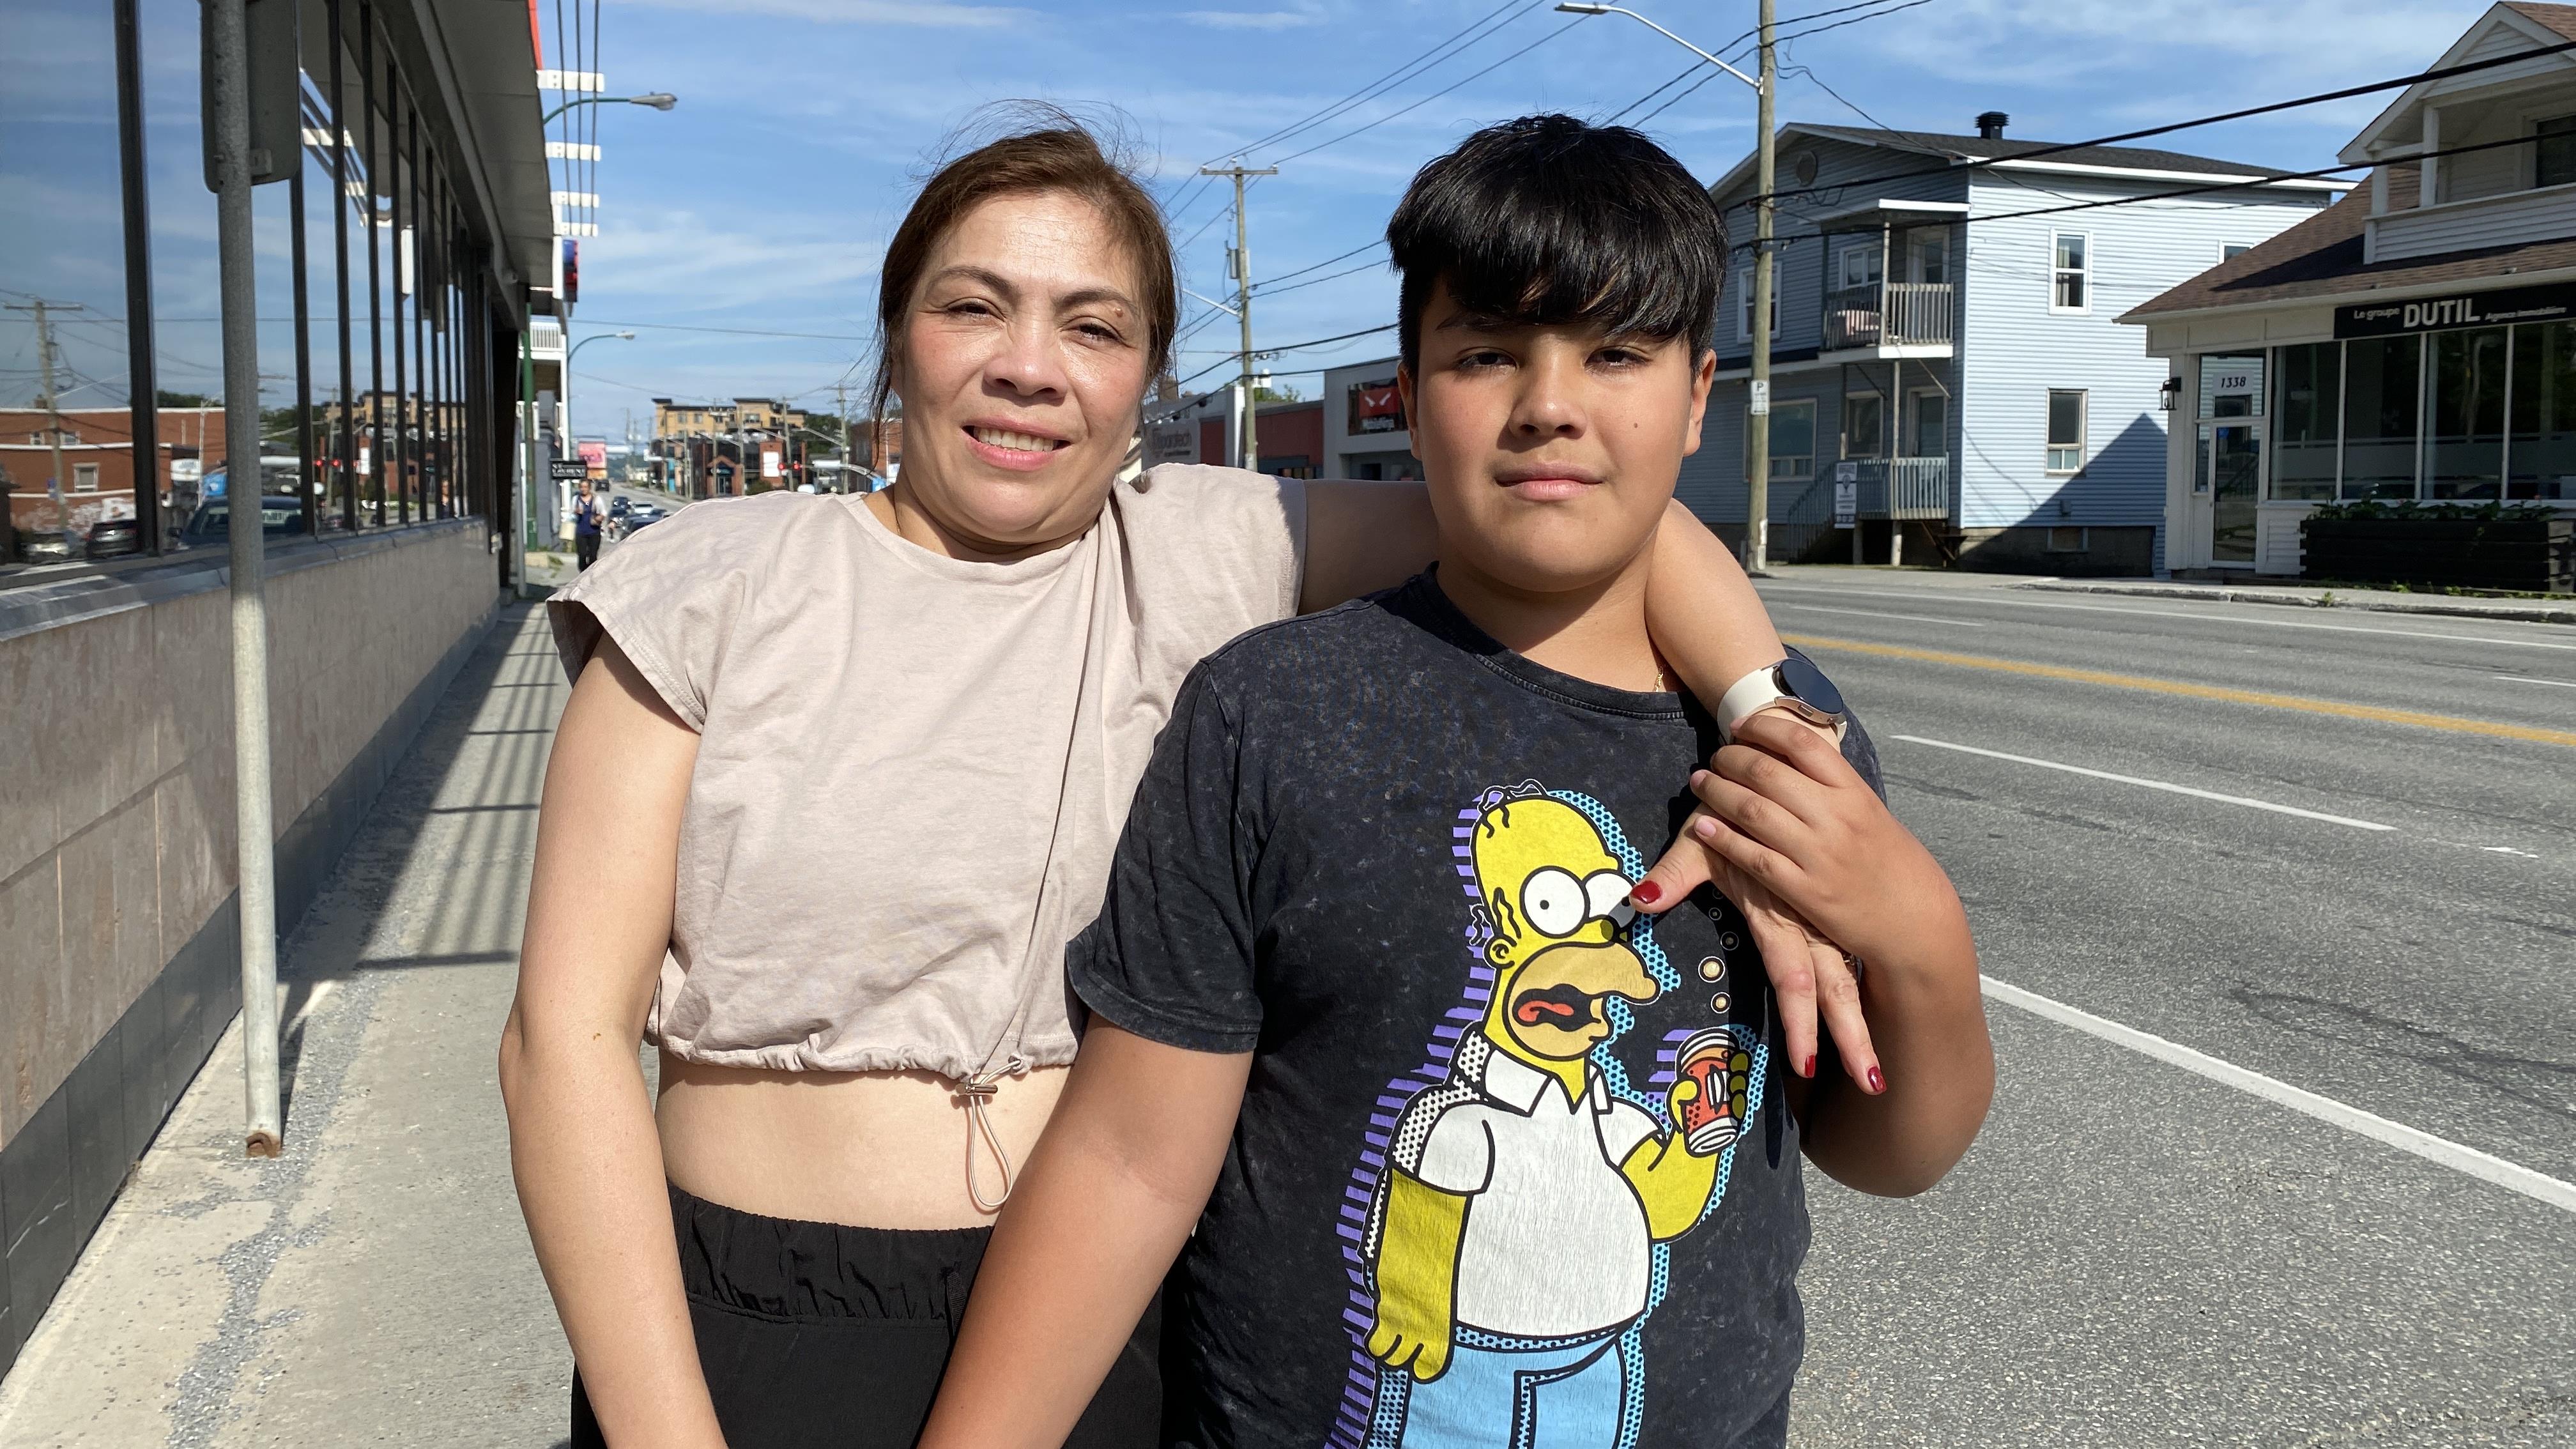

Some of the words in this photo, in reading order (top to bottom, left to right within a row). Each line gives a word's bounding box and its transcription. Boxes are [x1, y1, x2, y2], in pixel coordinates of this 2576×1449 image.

[2354, 310, 2365, 319] Le
[2366, 308, 2400, 320] groupe
[2404, 298, 2481, 328] DUTIL
[1757, 383, 1764, 392] P
[2221, 376, 2246, 388] 1338
